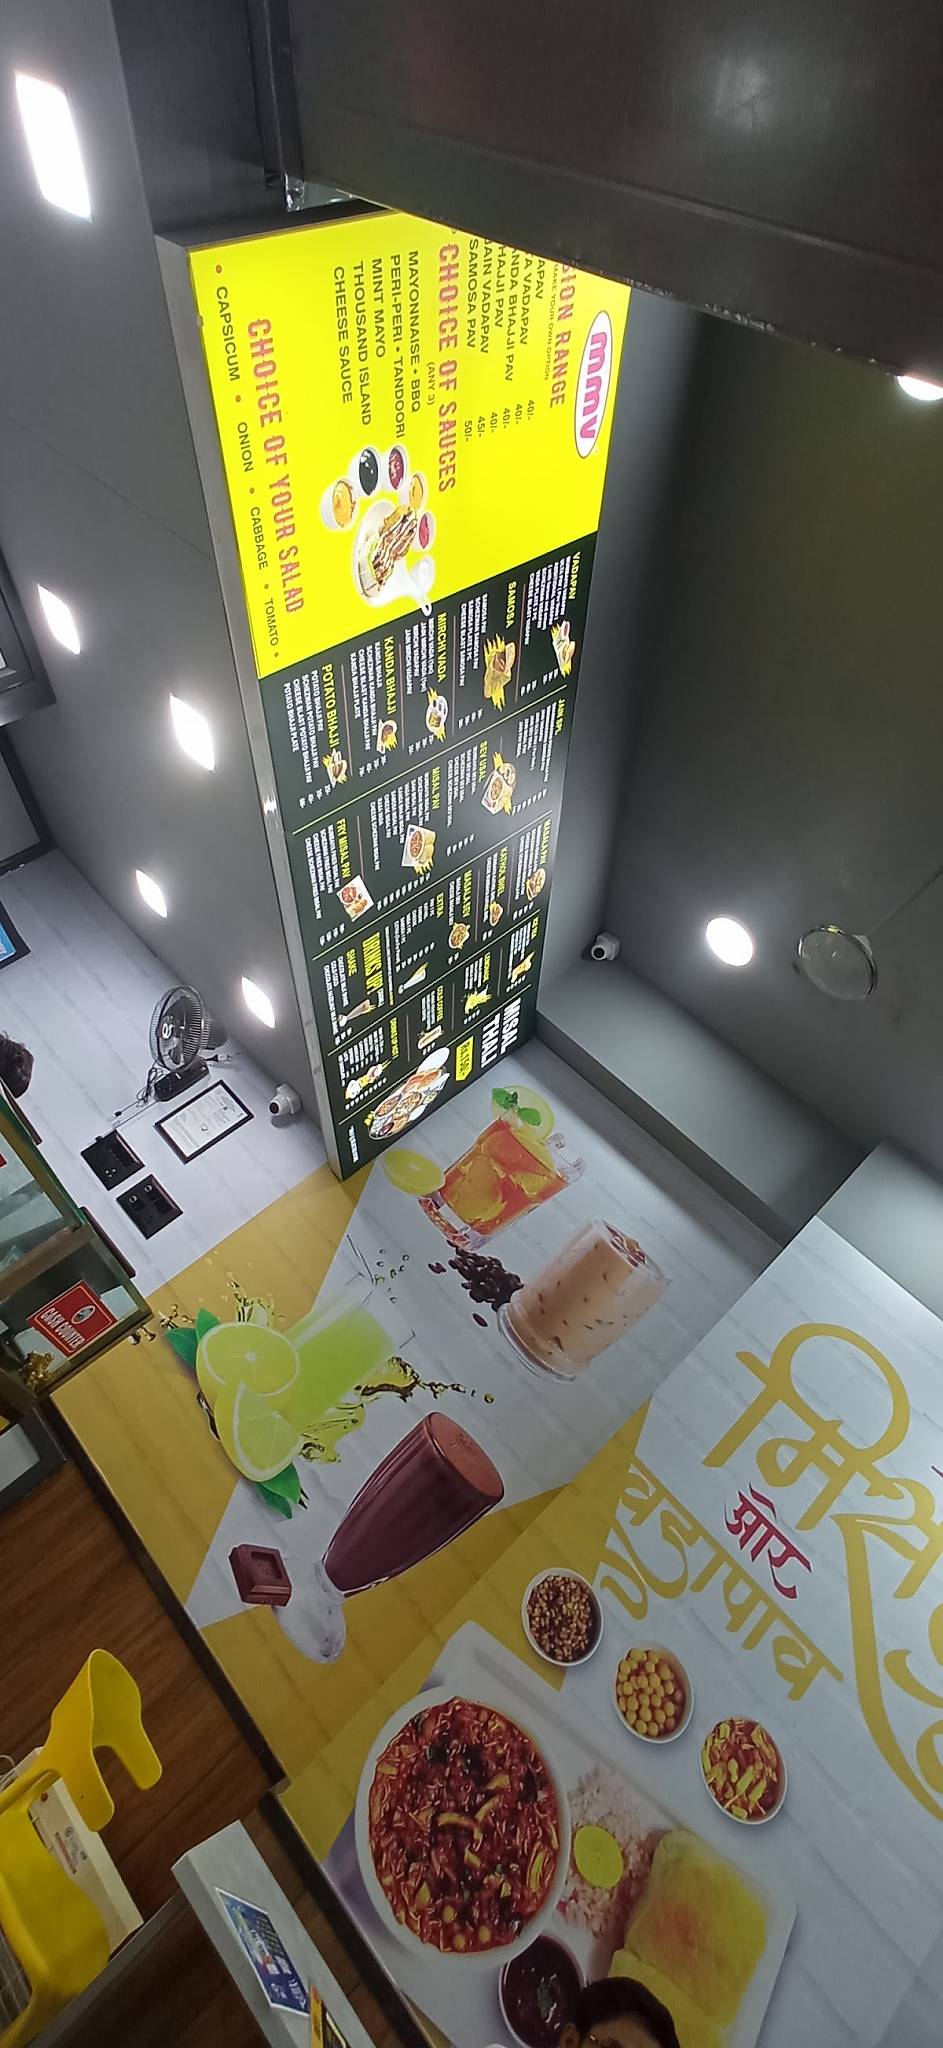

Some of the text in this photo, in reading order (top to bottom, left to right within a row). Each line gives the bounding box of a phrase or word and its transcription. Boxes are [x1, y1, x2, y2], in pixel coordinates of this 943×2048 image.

[466, 237, 478, 350] SAMOSA PAV
[493, 244, 506, 329] HAJJI PAV
[534, 257, 546, 301] APAV
[371, 257, 385, 359] MINT MAYO
[407, 250, 420, 414] MAYONNAISE BBQ
[479, 279, 490, 355] VADAPAV
[505, 294, 517, 350] BHAJJI
[518, 272, 532, 346] VADAPAV
[548, 293, 556, 320] YOUR
[332, 265, 352, 404] CHEESE SAUCE
[352, 260, 371, 426] THOUSAND ISLAND
[389, 254, 404, 439] PERI-PERI TANDOORI
[546, 322, 554, 344] OWN
[425, 360, 434, 406] (ANY 3)
[437, 241, 459, 493] CHOICE OF SAUCES
[504, 353, 514, 383] PAV
[543, 345, 552, 381] OPTION
[549, 330, 571, 409] RANGE
[463, 418, 472, 443] 50/-
[476, 414, 485, 438] 45/-
[489, 410, 498, 434] 40/-
[501, 406, 510, 429] 40/-
[514, 402, 523, 425] 40/-
[526, 398, 535, 421] 40/-
[214, 284, 280, 648] CAPSICUM ONION CABBAGE TOMATO
[245, 315, 305, 616] CHOICE OF YOUR SALAD
[567, 551, 580, 602] VADAPAV
[505, 579, 516, 628] SAMOSA
[436, 611, 445, 683] MIRCHI VADA
[383, 635, 396, 715] KANDA BHAJJI
[321, 662, 339, 748] POTATO BHAJJI
[478, 739, 487, 782] SEV USAL
[431, 766, 439, 811] MISAL PAV
[336, 817, 350, 879] FRY MISAL PAV
[540, 818, 550, 852] MASALA
[462, 869, 471, 919] MASALA SEV
[345, 947, 357, 977] SHAKE
[361, 931, 382, 977] DRINKS
[365, 969, 383, 996] UP!
[480, 1011, 500, 1069] THALI
[500, 996, 521, 1055] MISAL
[40, 1307, 86, 1349] CASH COUNTER
[601, 1455, 844, 1702] वडापाव
